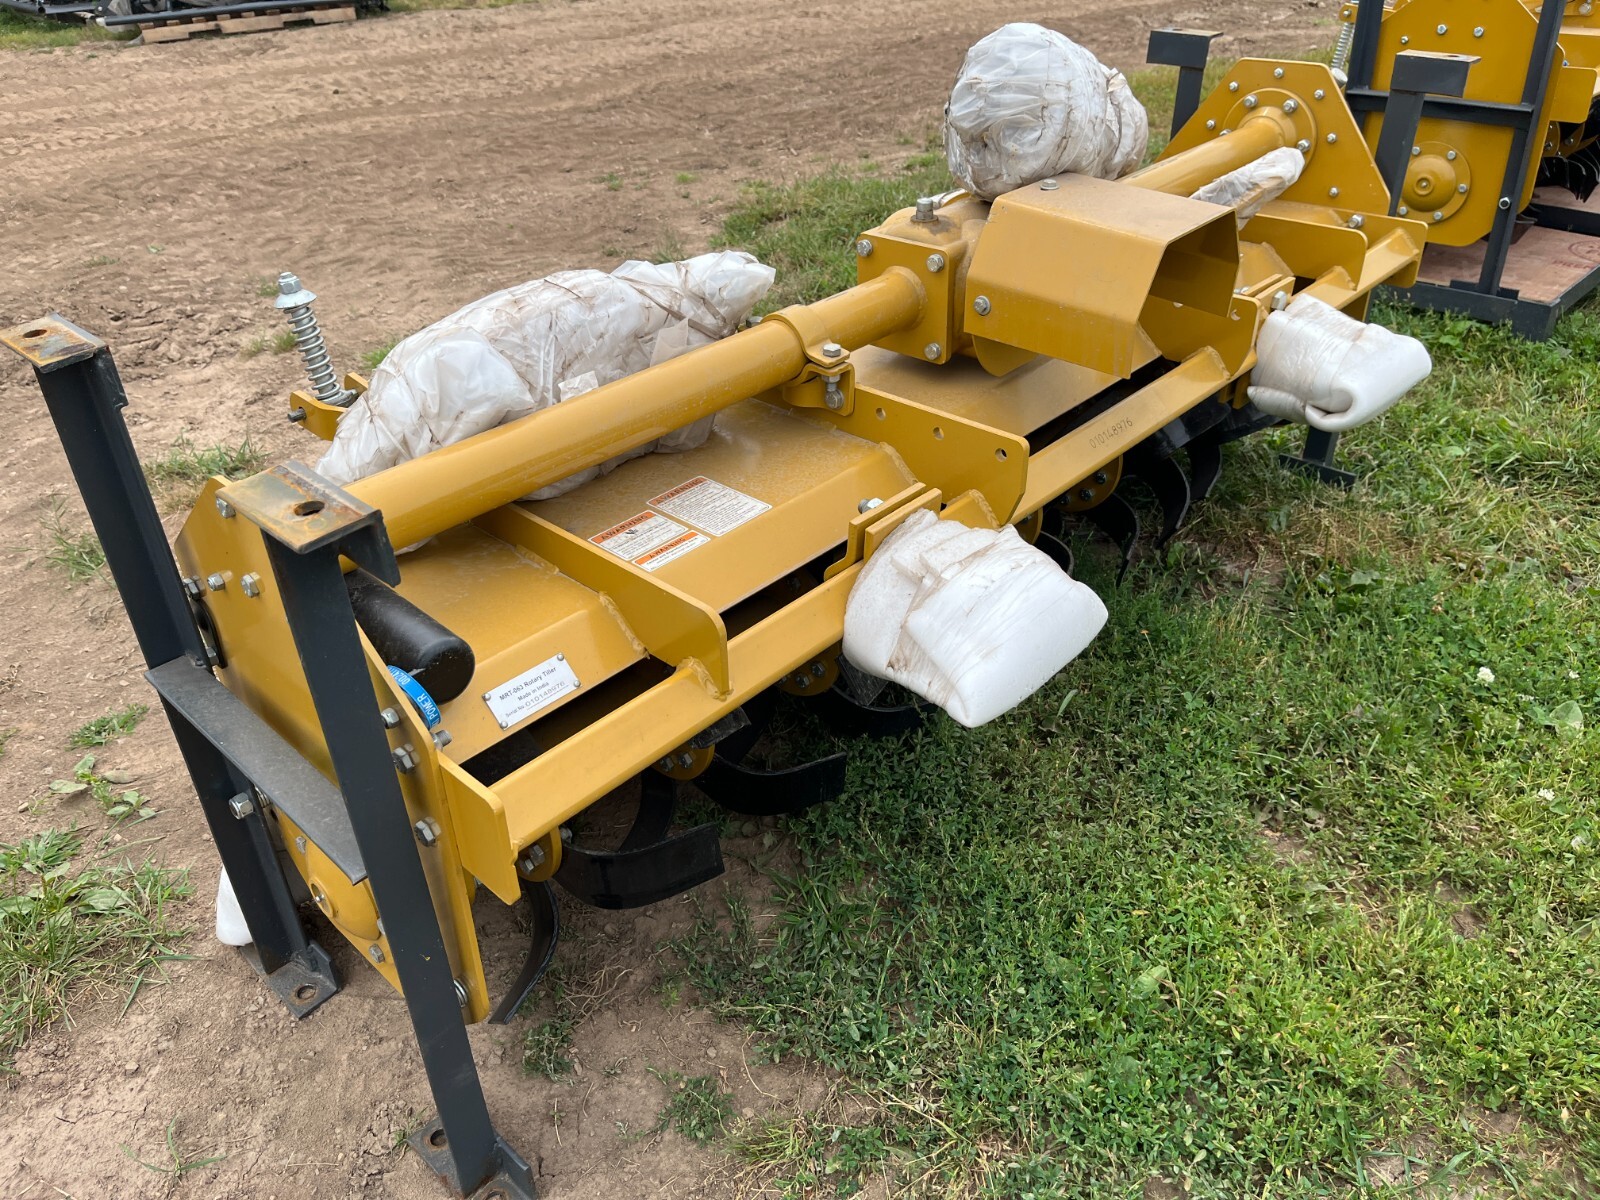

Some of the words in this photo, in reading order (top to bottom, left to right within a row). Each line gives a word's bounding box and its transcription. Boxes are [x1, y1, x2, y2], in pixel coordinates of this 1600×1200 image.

[1089, 417, 1133, 449] 010148976
[523, 674, 543, 688] Rotary
[542, 666, 557, 677] Tiller
[517, 690, 531, 701] Made
[536, 681, 550, 691] India
[416, 693, 438, 720] POWER
